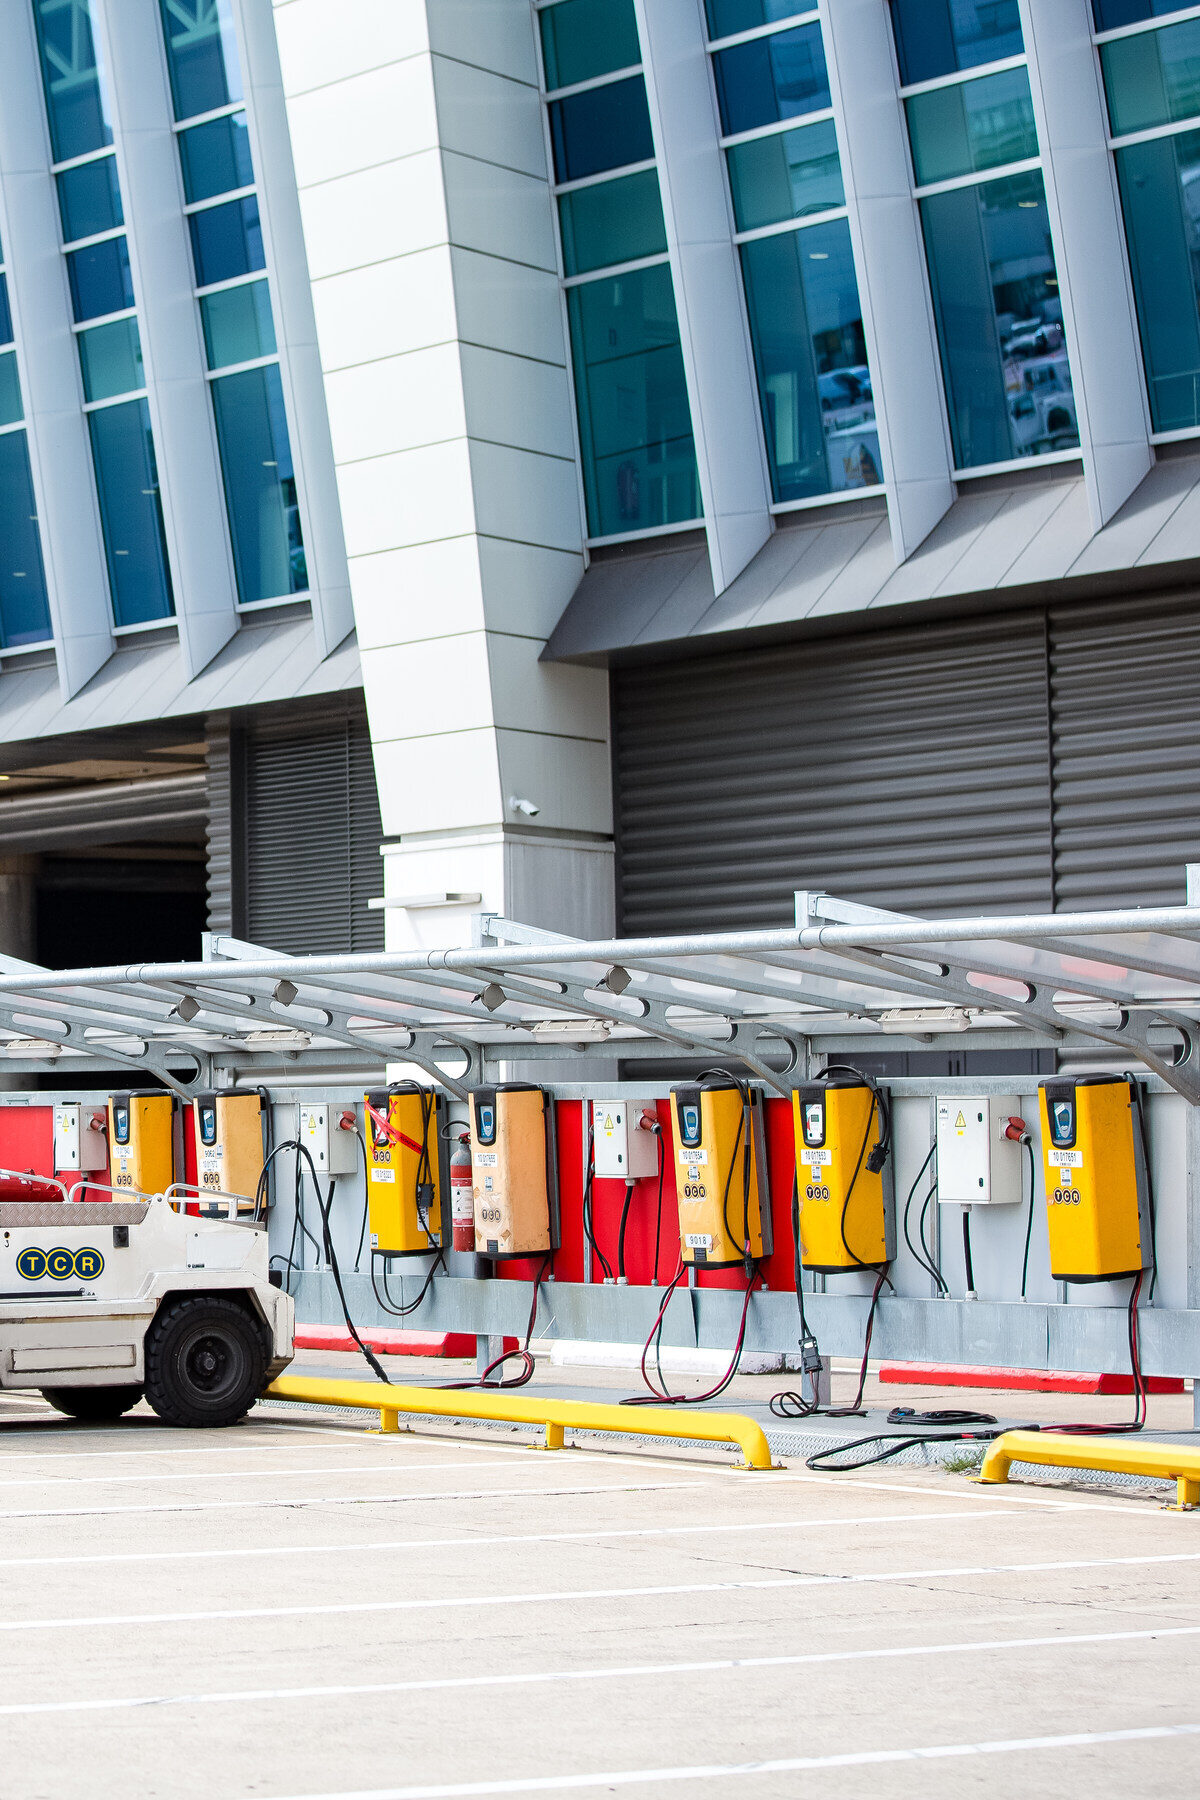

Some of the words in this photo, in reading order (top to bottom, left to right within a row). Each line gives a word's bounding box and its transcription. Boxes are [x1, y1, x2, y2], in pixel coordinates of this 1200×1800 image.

[685, 1185, 706, 1198] TCR
[806, 1186, 829, 1200] TCR
[1054, 1188, 1080, 1204] TCR
[689, 1235, 707, 1245] 9018
[24, 1253, 97, 1275] TCR
